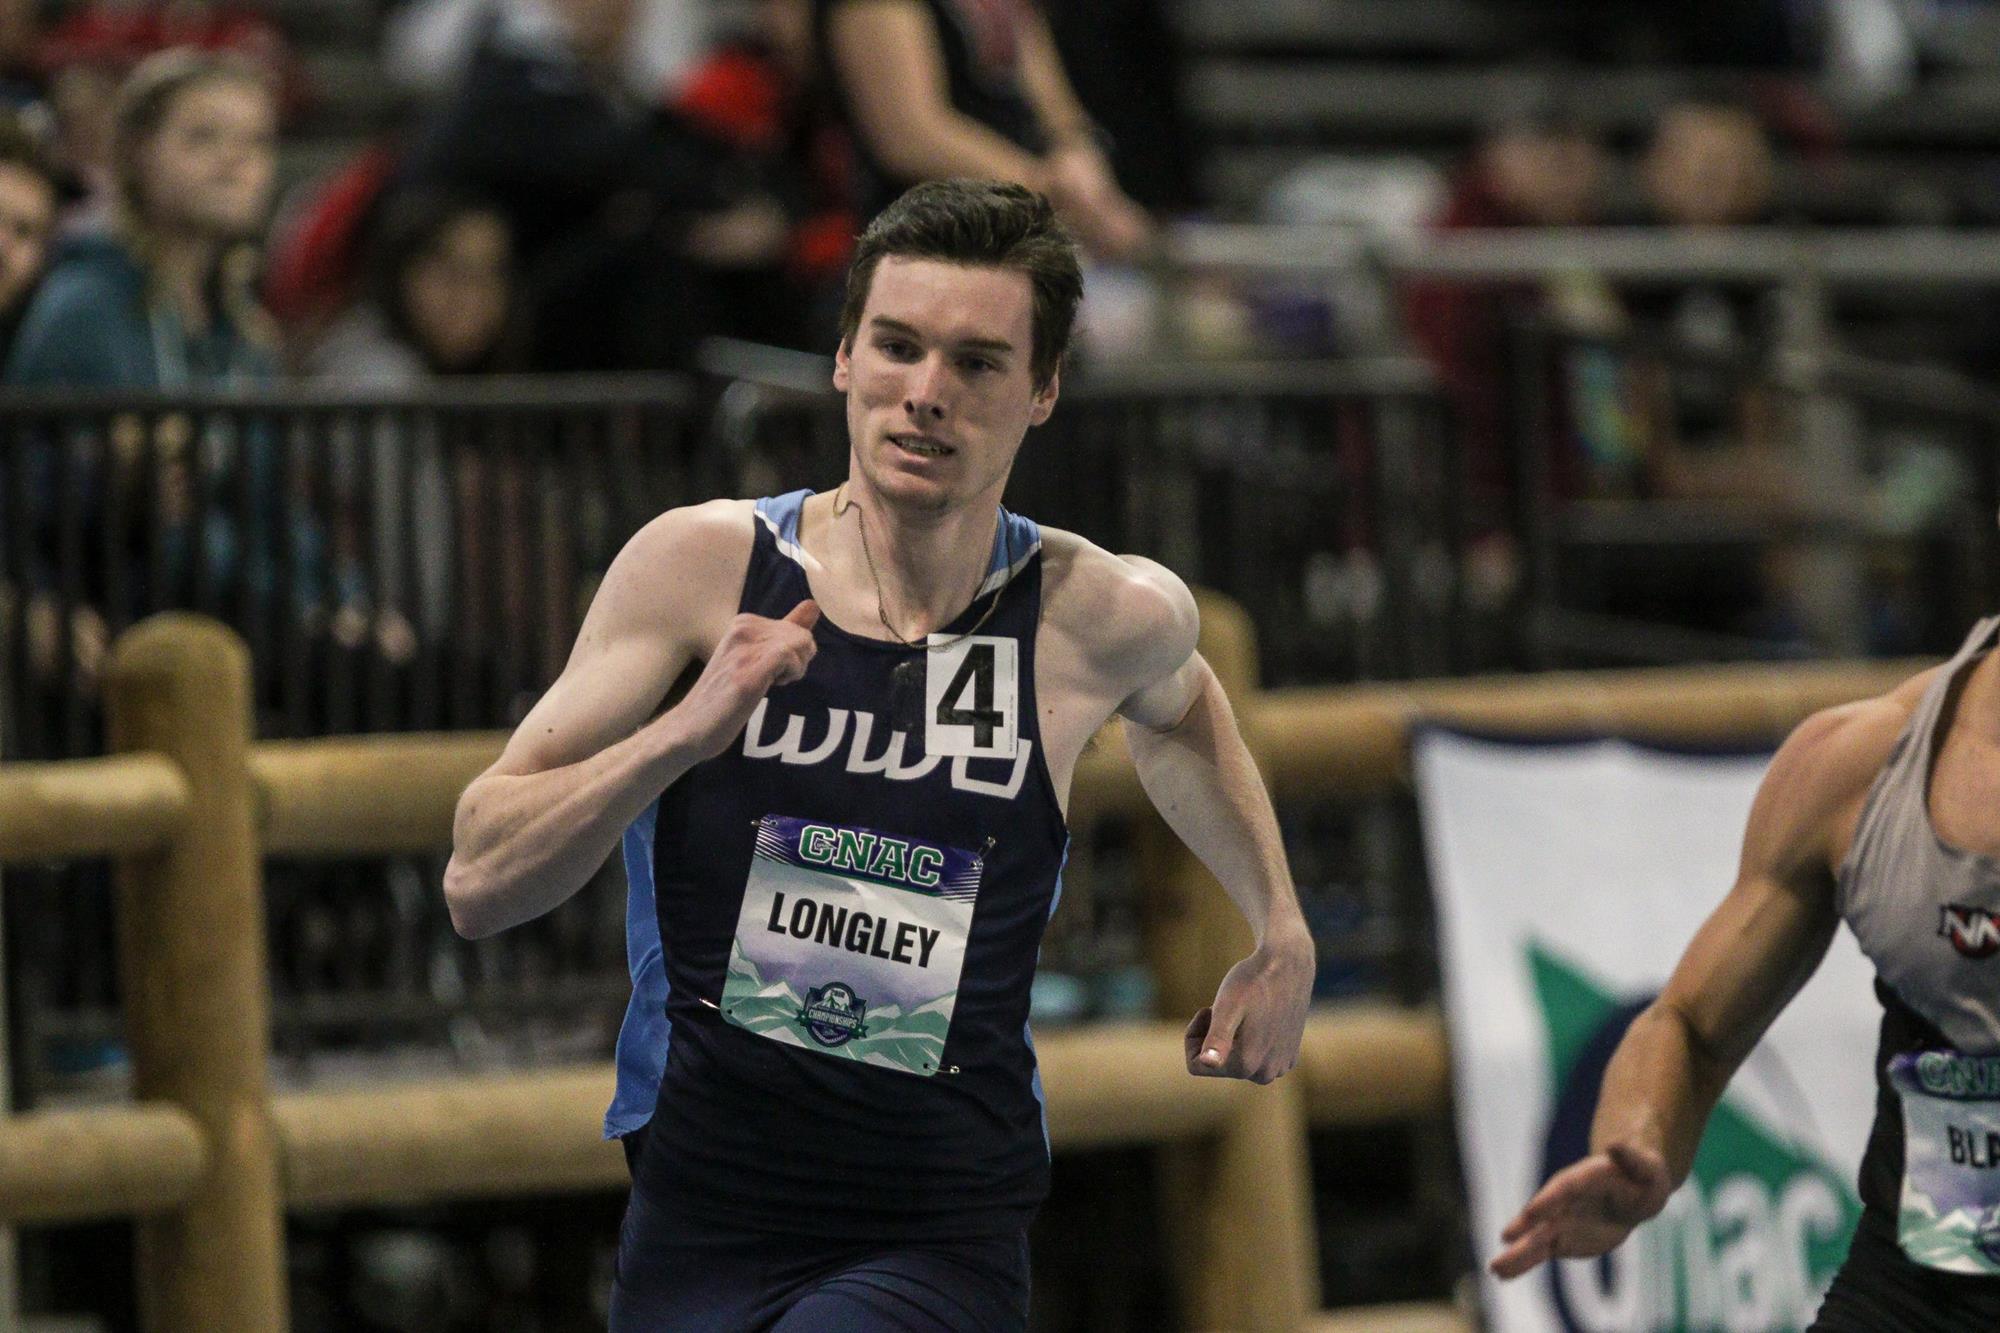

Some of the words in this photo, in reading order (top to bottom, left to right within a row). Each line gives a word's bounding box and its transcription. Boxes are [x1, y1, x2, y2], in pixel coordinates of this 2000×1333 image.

[936, 643, 1004, 749] 4
[798, 824, 944, 888] GNAC
[767, 891, 941, 969] LONGLEY
[808, 1008, 858, 1029] CHAMPIONSHIPS
